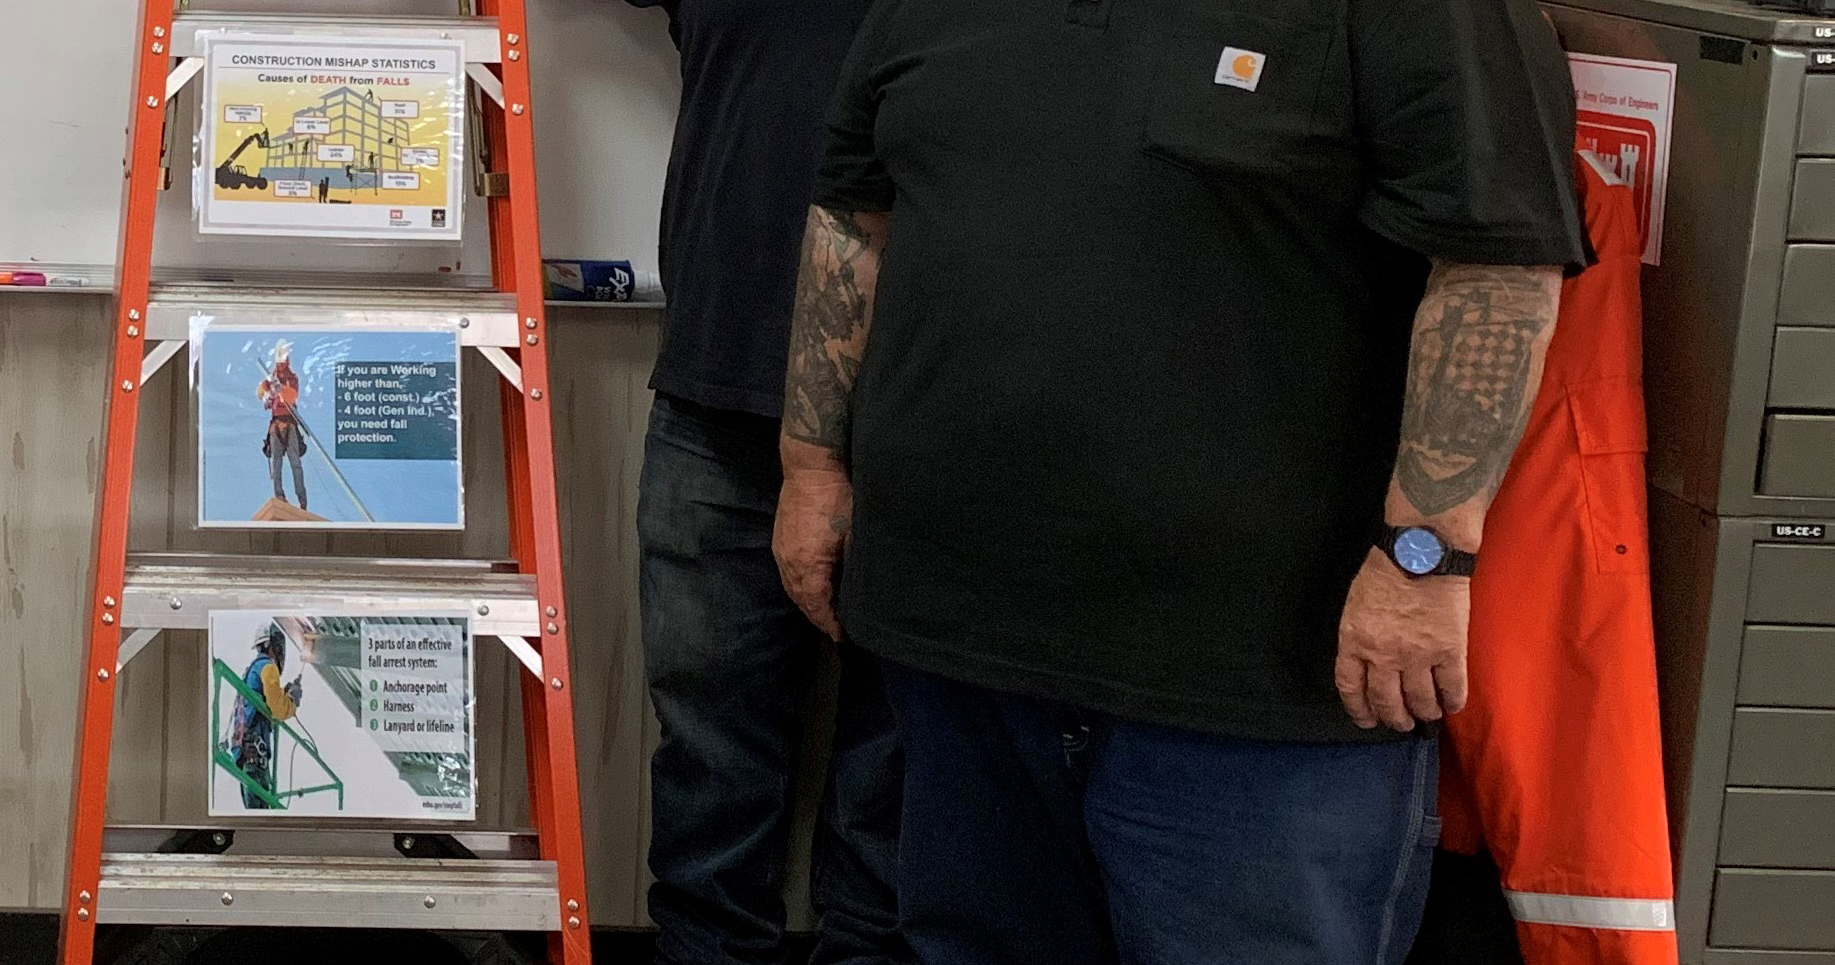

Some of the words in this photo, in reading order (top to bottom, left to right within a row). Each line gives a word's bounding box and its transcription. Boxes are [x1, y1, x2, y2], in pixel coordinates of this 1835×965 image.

[231, 55, 322, 66] CONSTRUCTION
[325, 57, 369, 67] MISHAP
[371, 59, 436, 69] STATISTICS
[257, 73, 294, 83] Causes
[296, 74, 308, 83] of
[310, 75, 346, 84] DEATH
[349, 76, 374, 85] from
[377, 77, 410, 86] FALLS
[337, 378, 373, 390] higher
[337, 420, 358, 431] you
[360, 419, 388, 429] need
[390, 419, 407, 429] fall
[337, 433, 397, 444] protection.
[1776, 526, 1821, 537] US-CE-C
[368, 637, 373, 650] 3
[374, 639, 396, 652] parts
[396, 637, 405, 650] of
[406, 640, 416, 650] an
[418, 638, 452, 650] effective
[368, 655, 382, 667] fall
[383, 657, 406, 668] arrest
[407, 657, 438, 670] system:
[383, 680, 425, 695] Anchorage
[426, 681, 448, 695] point
[383, 700, 415, 712] Harness
[383, 719, 415, 734] Lanyard
[416, 722, 425, 732] or
[426, 719, 455, 732] lifeline
